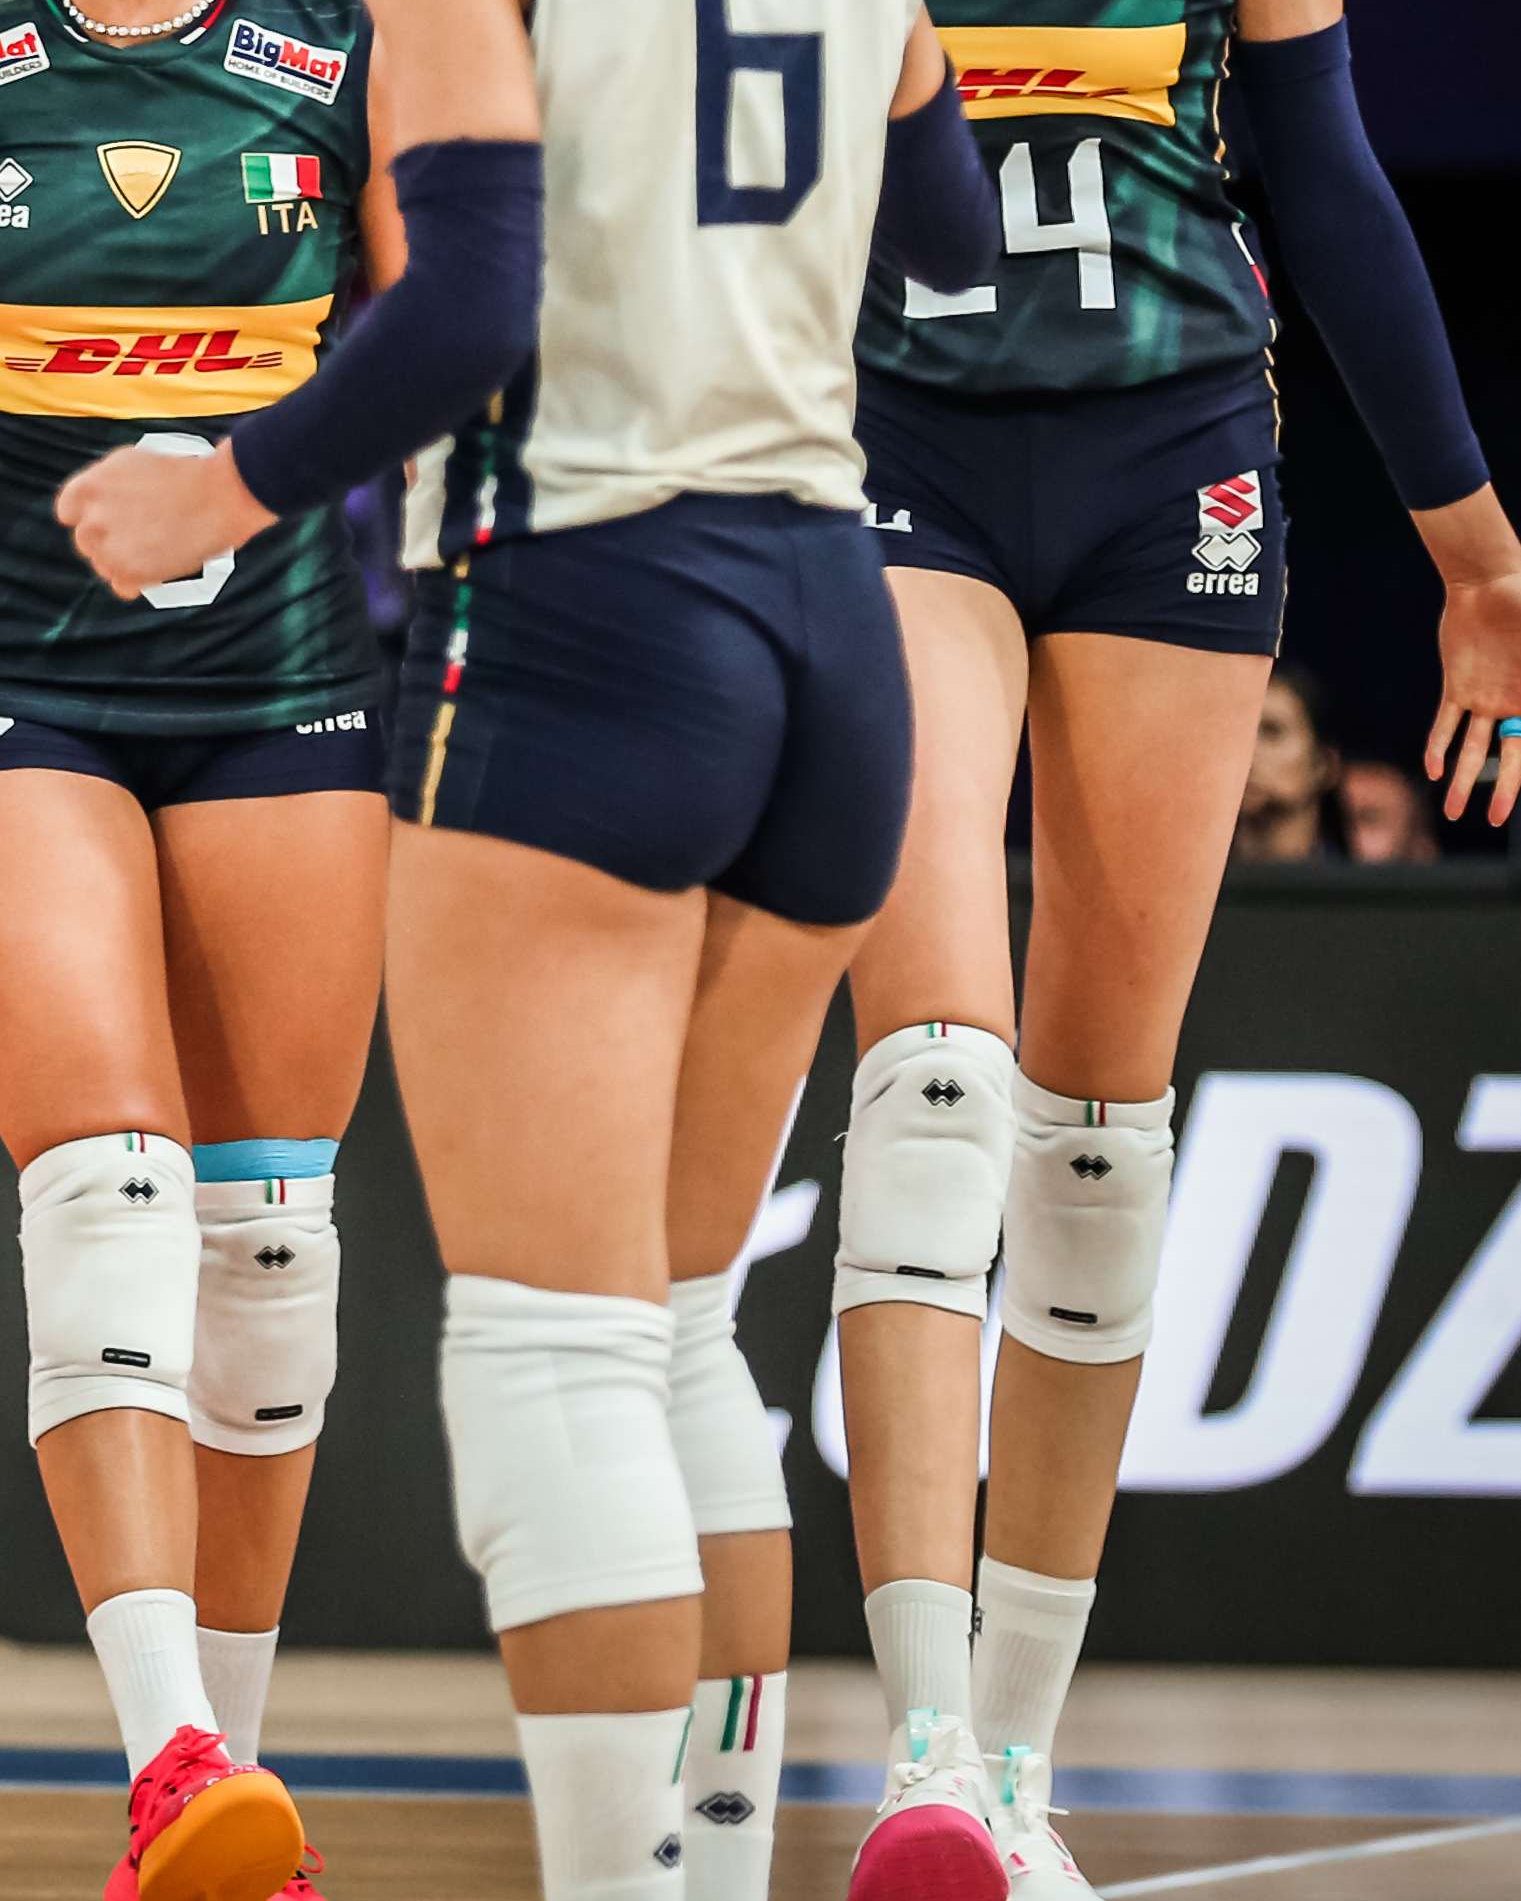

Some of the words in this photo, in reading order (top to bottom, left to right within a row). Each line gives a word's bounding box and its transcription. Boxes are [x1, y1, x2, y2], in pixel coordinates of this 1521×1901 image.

[234, 23, 341, 82] BigMat
[257, 203, 318, 235] ITA
[903, 137, 1116, 320] 4
[41, 329, 252, 376] DHL
[1186, 572, 1259, 596] errea
